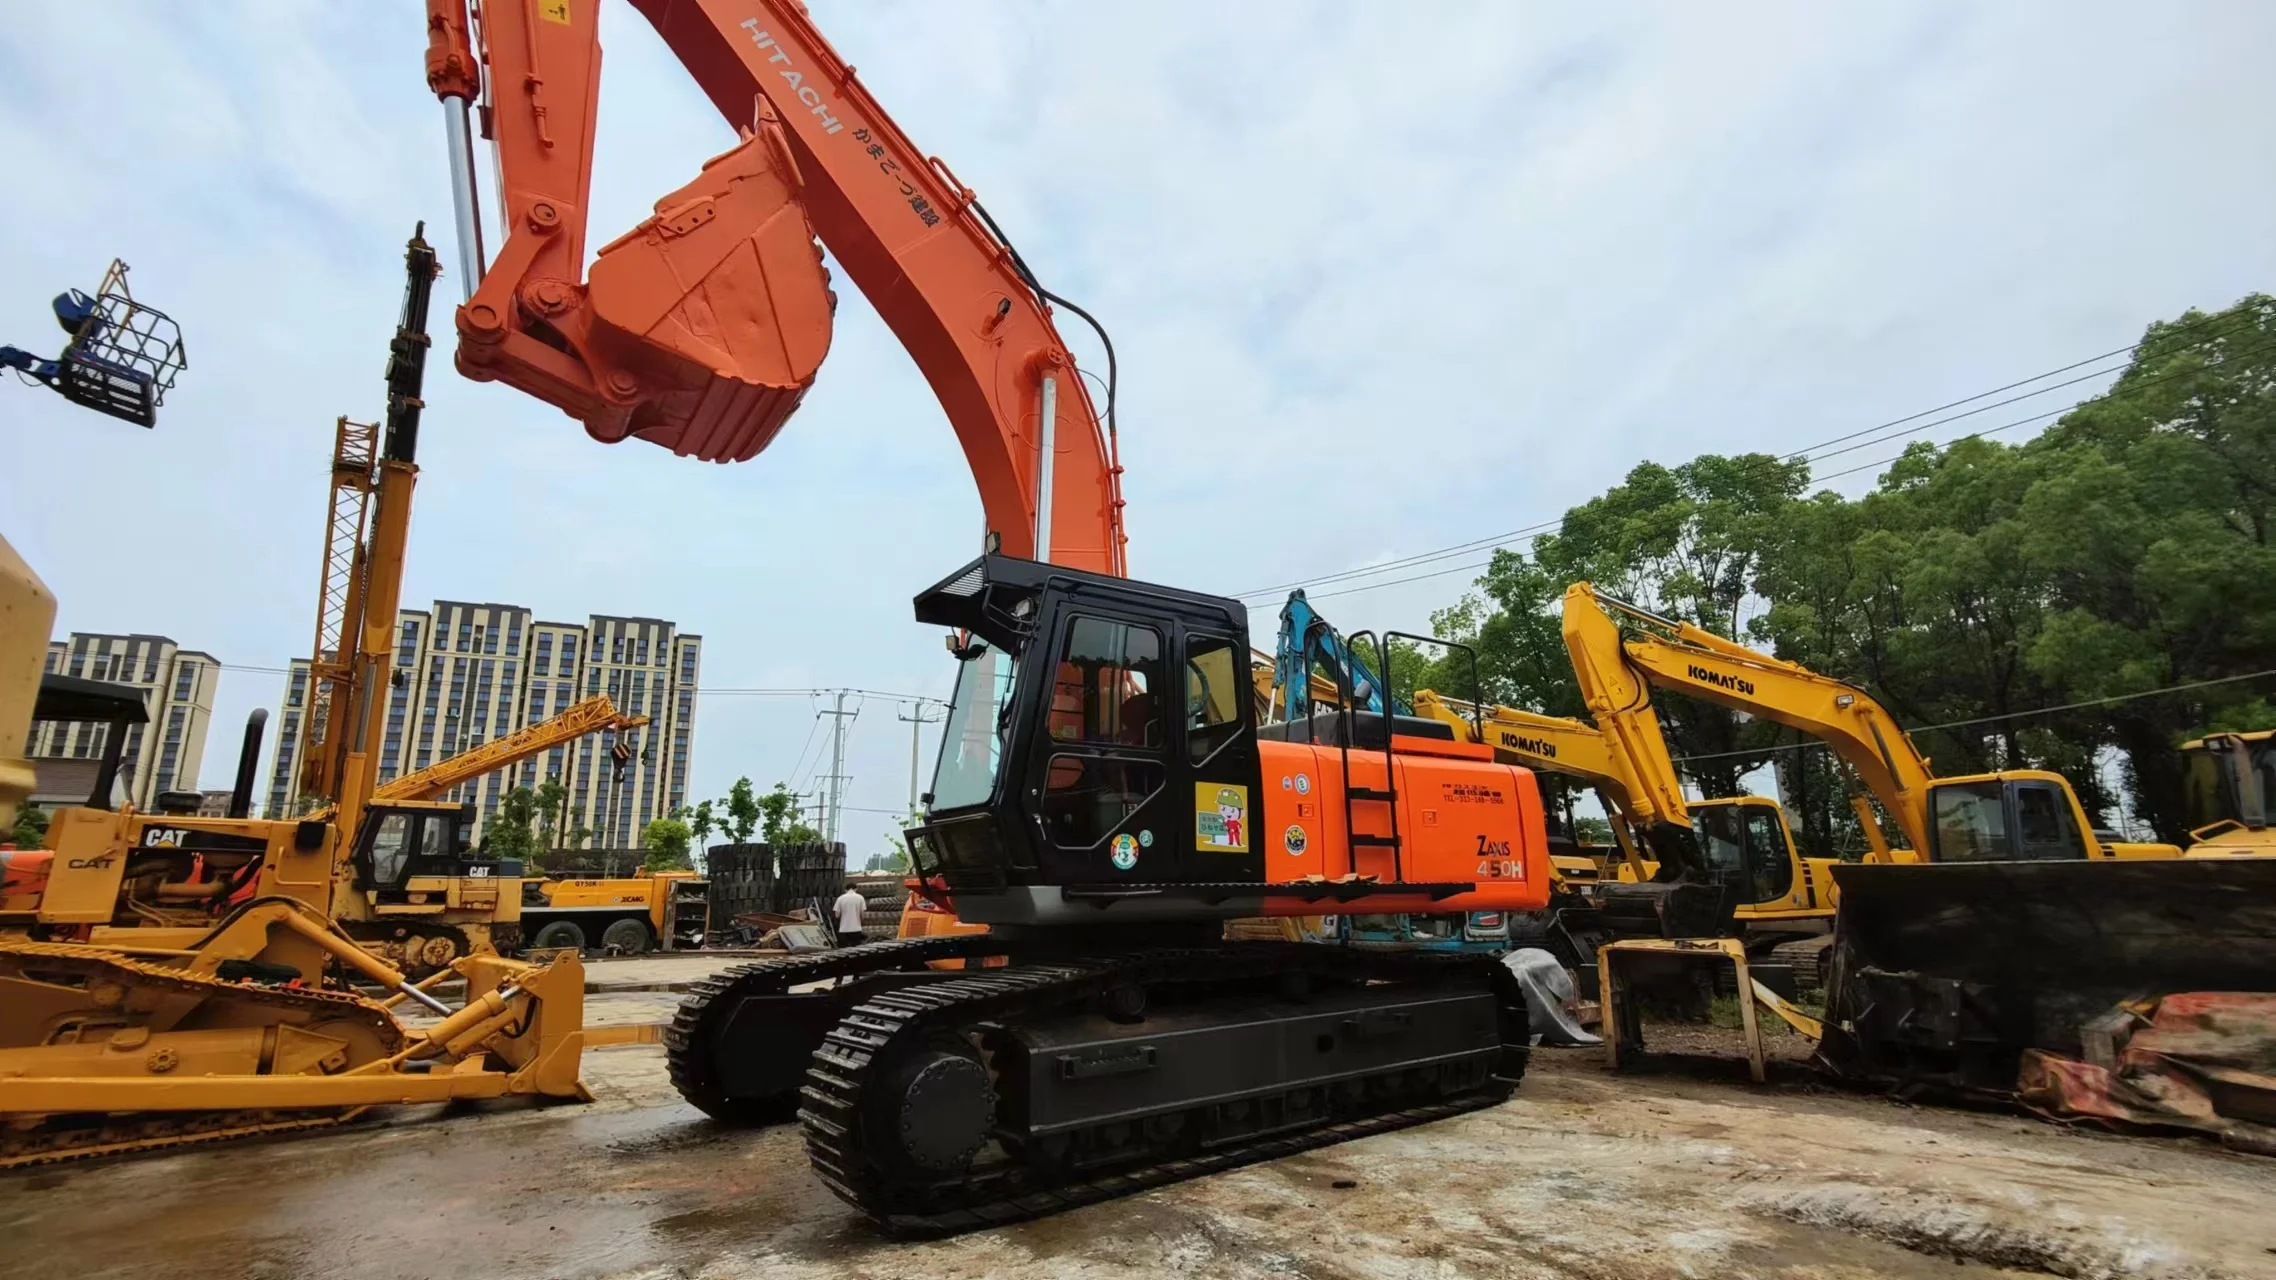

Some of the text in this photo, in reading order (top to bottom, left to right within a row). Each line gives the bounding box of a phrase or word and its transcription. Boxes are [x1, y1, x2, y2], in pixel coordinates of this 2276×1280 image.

[740, 17, 844, 135] HITACHI
[1688, 664, 1754, 695] KOMATSU
[1501, 731, 1556, 758] KOMATSU
[145, 828, 188, 848] CAT
[1476, 834, 1511, 857] ZAXIS
[68, 858, 116, 870] CAT
[469, 866, 490, 878] CAT
[1476, 859, 1523, 878] 450H
